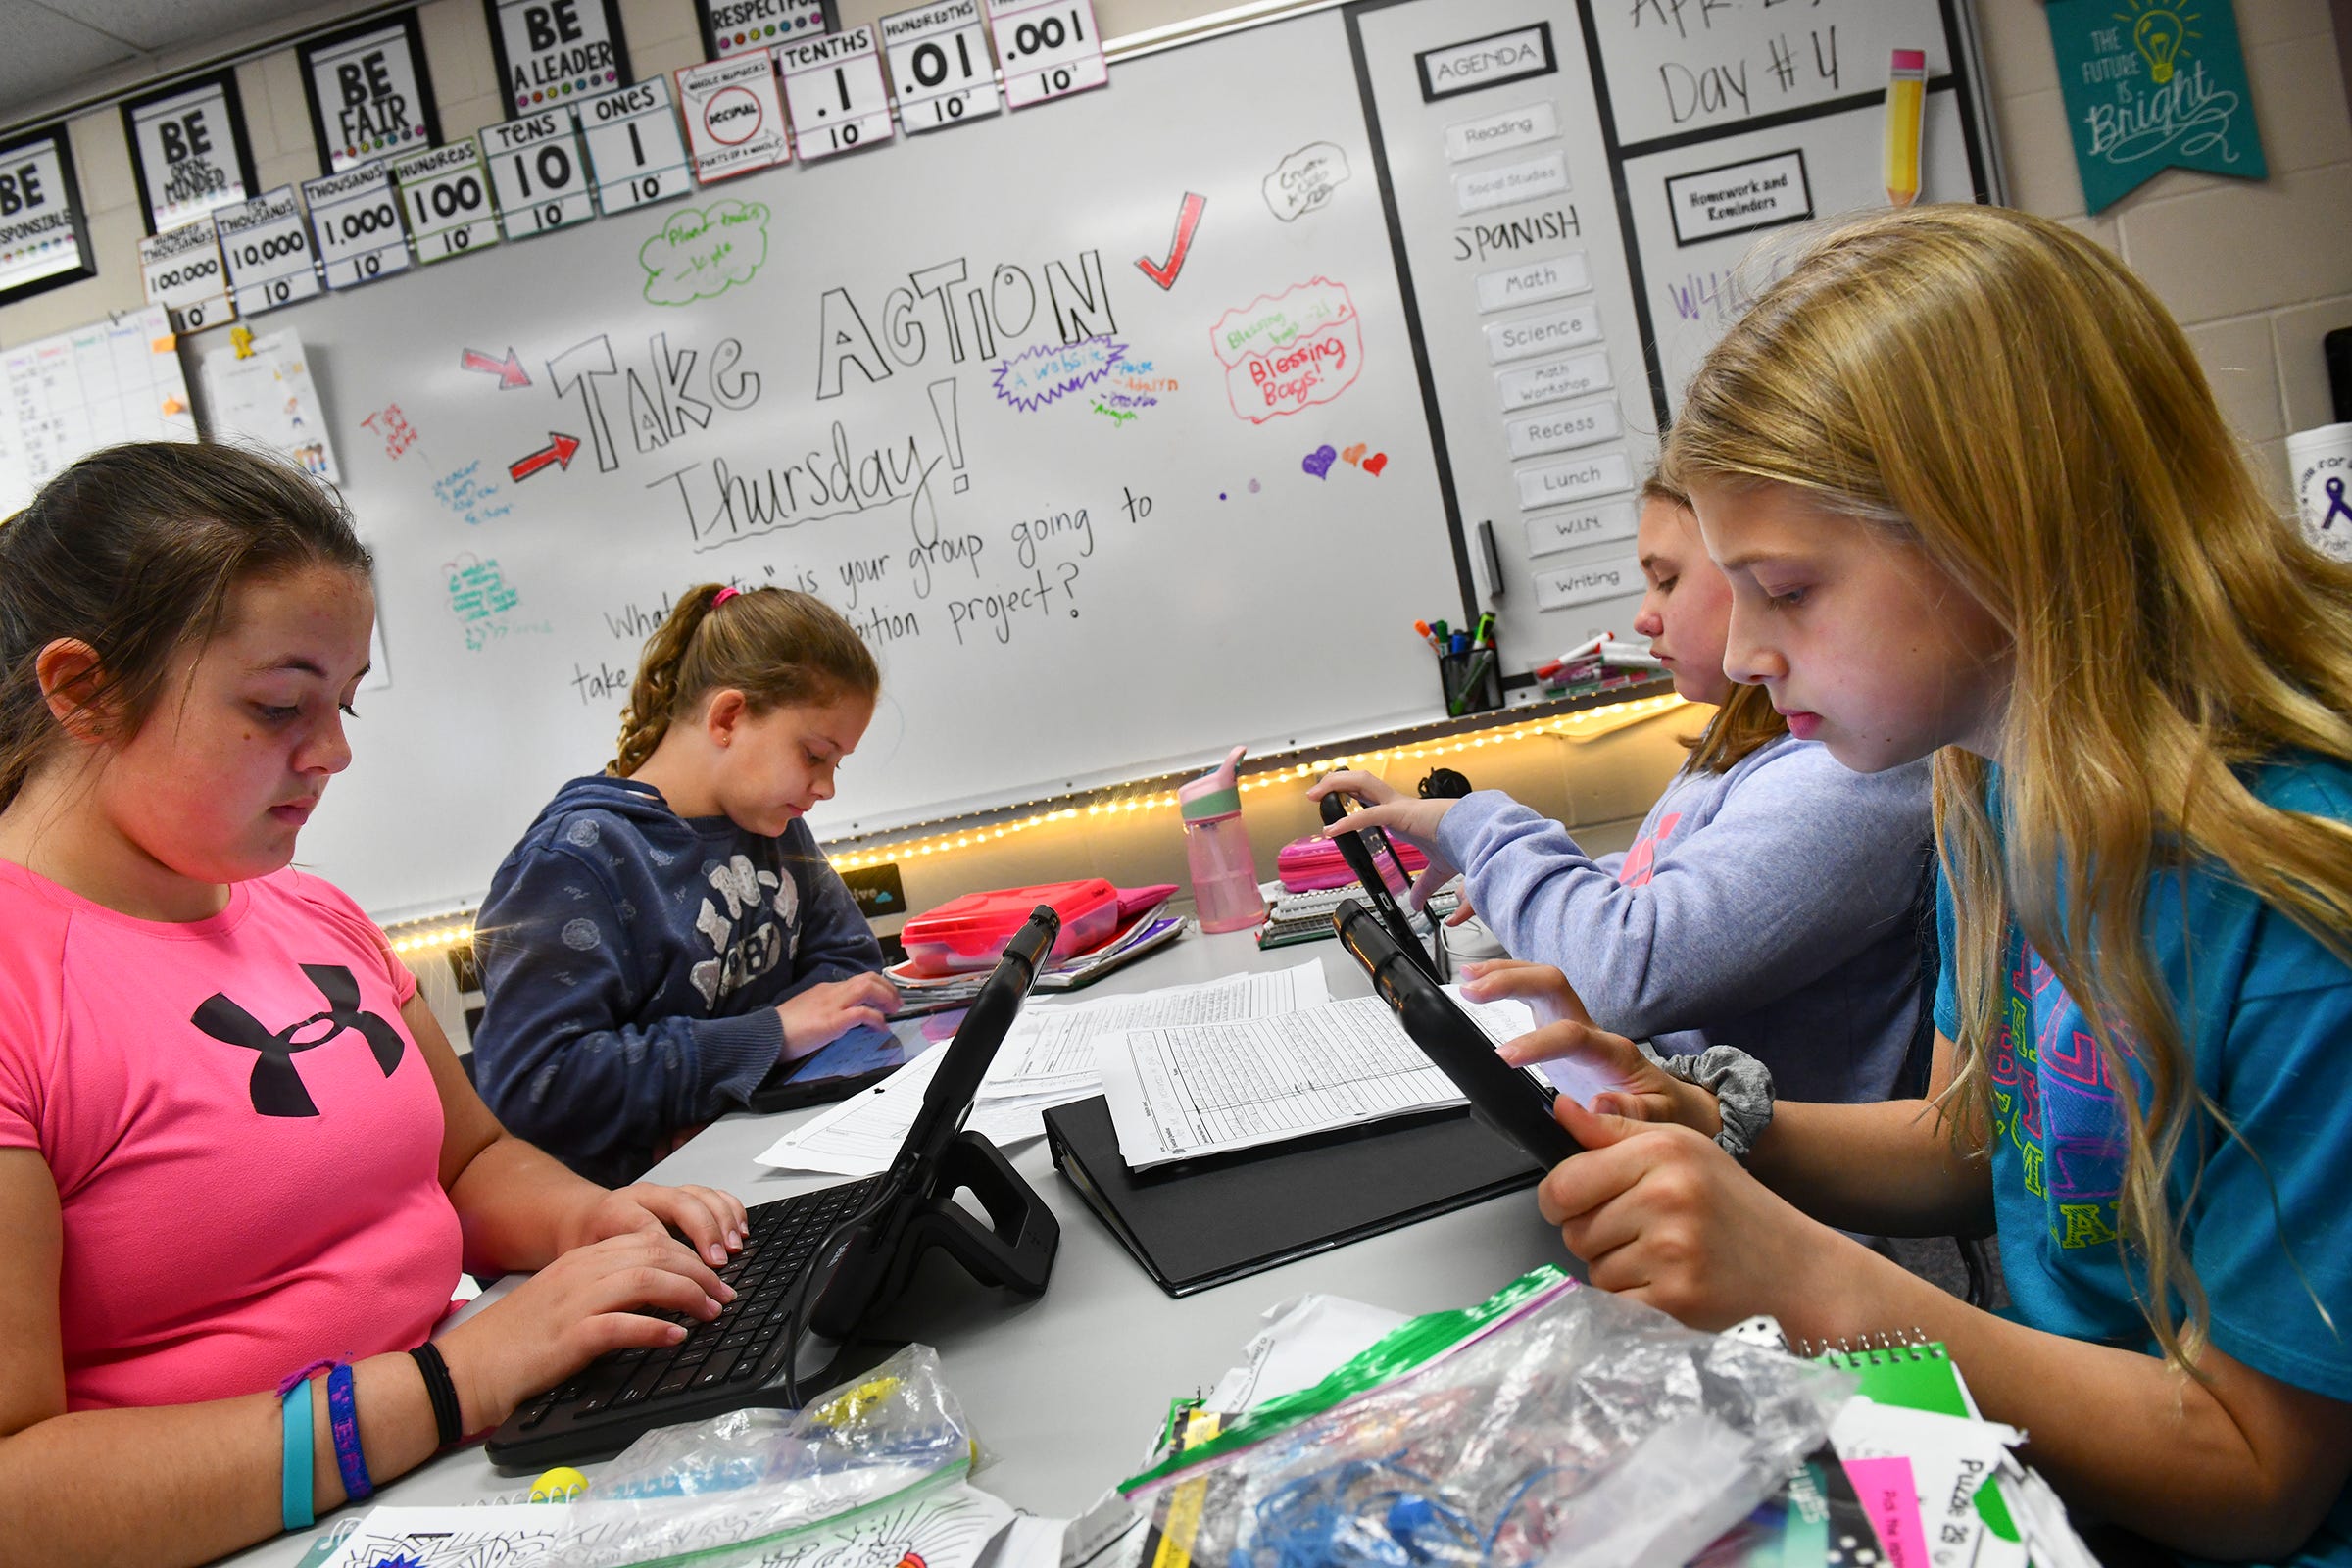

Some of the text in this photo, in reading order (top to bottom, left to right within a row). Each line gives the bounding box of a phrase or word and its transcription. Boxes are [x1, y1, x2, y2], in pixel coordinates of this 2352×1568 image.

[524, 0, 582, 52] BE
[710, 0, 821, 30] RESPECT
[1007, 10, 1084, 61] .001
[2090, 26, 2122, 55] THE
[337, 51, 392, 107] BE
[514, 40, 614, 92] A LEADER
[905, 33, 973, 94] .01
[1437, 43, 1537, 81] AGENDA
[2081, 50, 2141, 85] FUTURE
[2082, 60, 2227, 157] Bright
[2118, 80, 2133, 104] IS
[159, 110, 212, 165] BE
[338, 95, 410, 146] FAIR
[1465, 118, 1533, 144] Reading
[628, 122, 645, 167] 1
[0, 163, 45, 217] BE
[307, 164, 384, 200] THOUSANDS
[514, 145, 571, 198] 10
[1467, 168, 1556, 196] Social Studies
[1690, 173, 1788, 208] Homework and
[413, 175, 481, 224] 100
[1707, 195, 1777, 221] Reminders
[325, 204, 396, 245] 1,000
[233, 232, 305, 270] 10,000
[150, 259, 219, 294] 100,000
[1505, 267, 1558, 294] Math
[1502, 318, 1583, 348] Science
[1250, 338, 1346, 386] Blessing
[1535, 364, 1570, 381] Math
[1262, 364, 1324, 407] Bags!
[1520, 377, 1592, 402] Workshop
[1528, 416, 1596, 441] Recess
[1544, 466, 1602, 491] Lunch
[839, 551, 890, 610] your
[909, 534, 982, 598] group
[1011, 505, 1093, 567] going
[1121, 486, 1152, 523] to
[1555, 570, 1620, 593] Writing
[571, 662, 628, 706] take
[845, 604, 920, 647] bition
